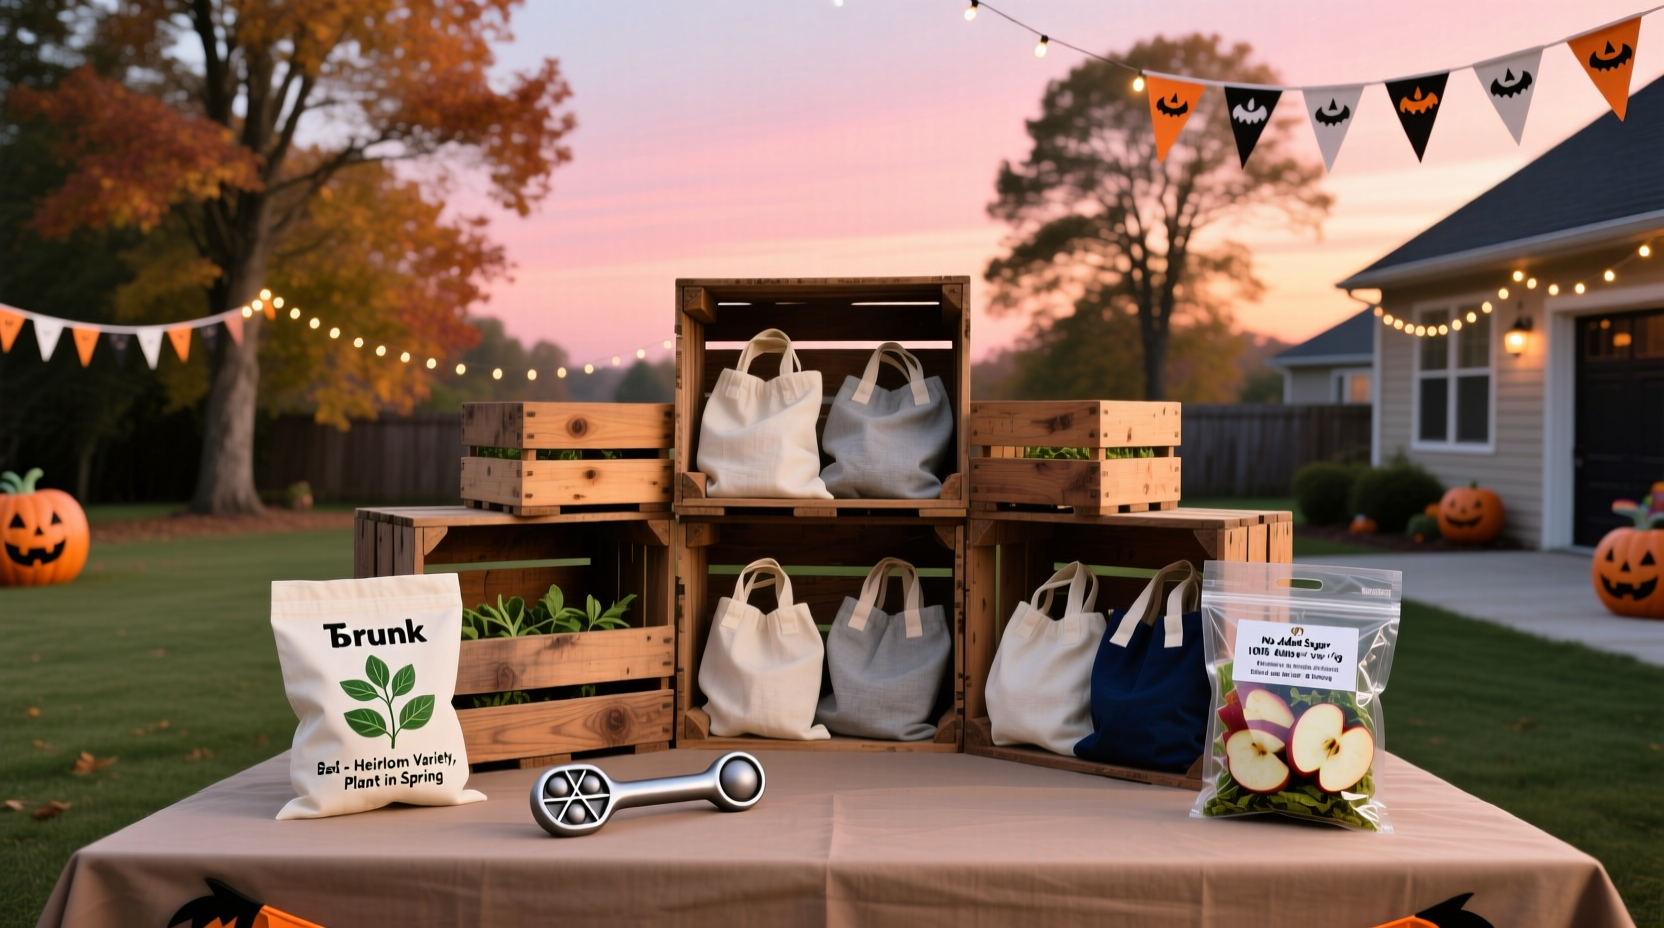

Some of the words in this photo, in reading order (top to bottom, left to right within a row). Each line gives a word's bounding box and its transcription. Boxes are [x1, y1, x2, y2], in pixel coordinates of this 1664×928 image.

[354, 757, 410, 772] Heirlom
[344, 774, 381, 791] Plant
[384, 771, 397, 787] in
[400, 769, 444, 788] Spring
